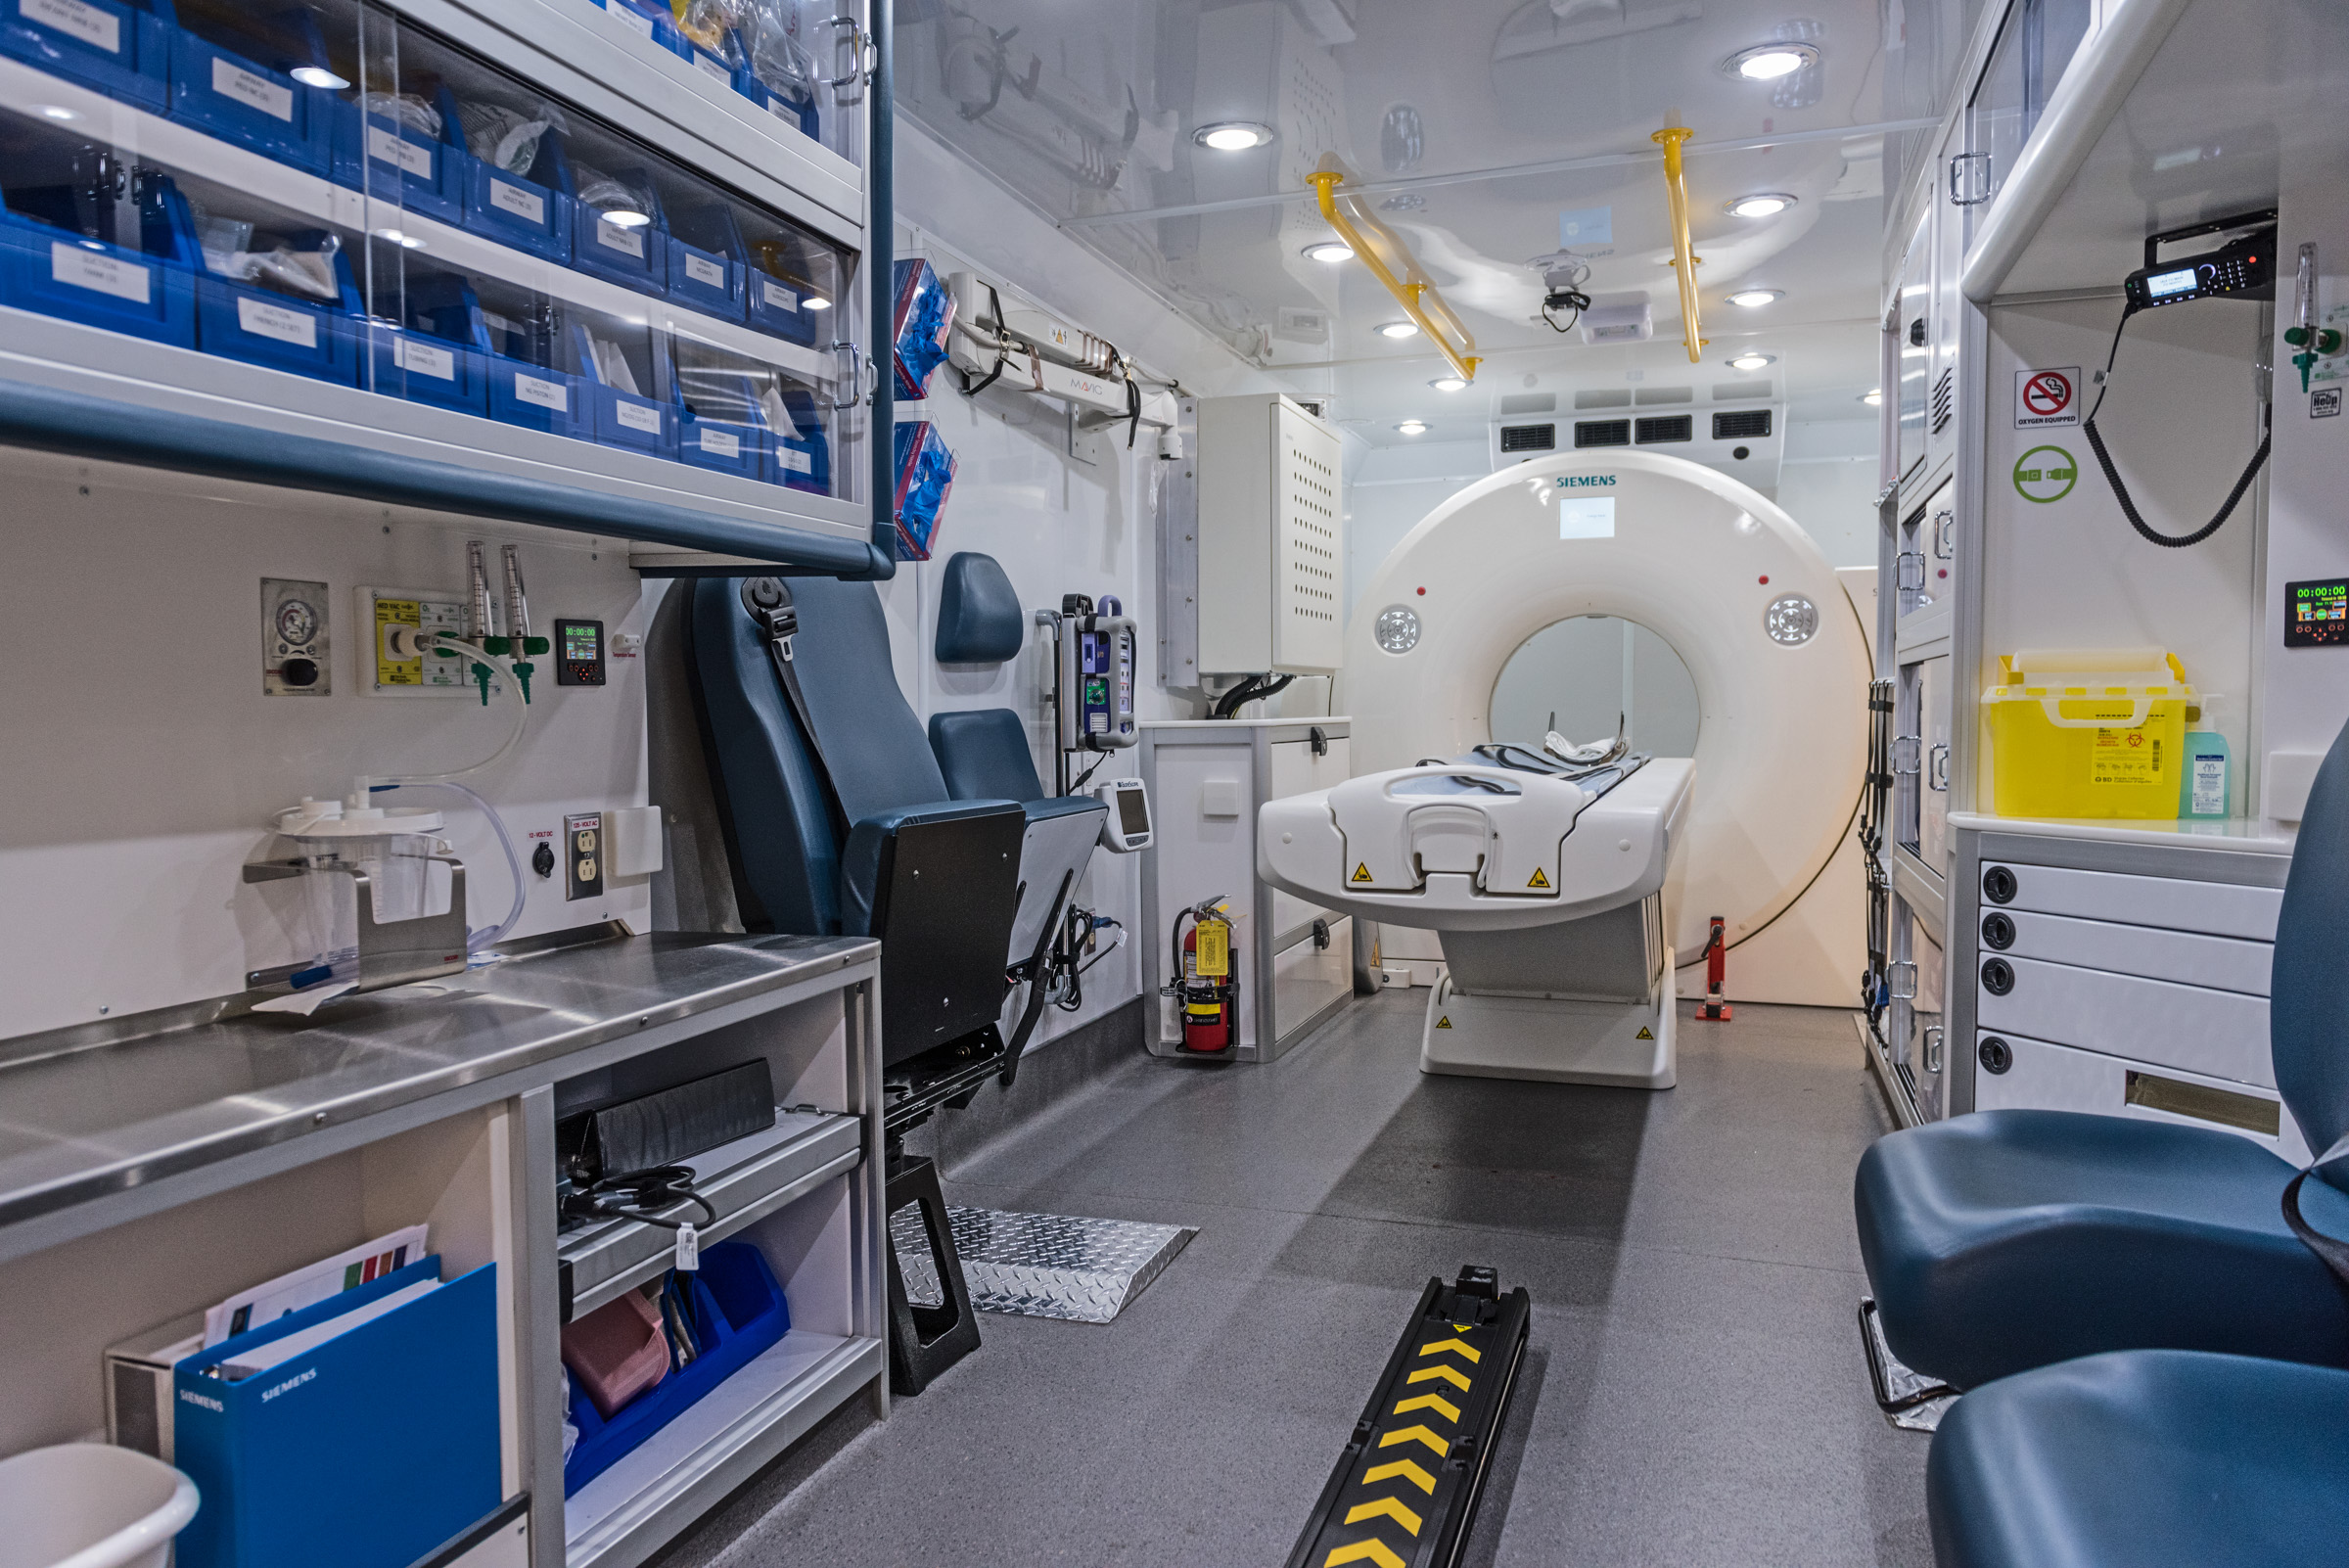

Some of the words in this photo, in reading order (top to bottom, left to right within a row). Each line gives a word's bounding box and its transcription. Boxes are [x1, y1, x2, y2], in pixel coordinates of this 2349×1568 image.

[508, 186, 525, 199] AIRWAY
[503, 193, 517, 205] ADULT
[605, 232, 618, 242] ADULT
[697, 259, 710, 269] AIRWAY
[774, 286, 785, 294] AIRWAY
[262, 306, 290, 320] SUCTION
[410, 343, 432, 356] SUCTION
[408, 353, 427, 364] TUBING
[530, 380, 549, 390] SUCTION
[1070, 378, 1103, 395] MAVIG
[532, 388, 548, 398] PISTON
[629, 406, 645, 415] SUCTION
[1557, 475, 1616, 488] SIEMENS
[2297, 586, 2345, 598] 00:00:00
[566, 628, 595, 636] 00:00:00
[262, 1368, 317, 1403] SIEMENS
[179, 1389, 224, 1412] SIEMENS
